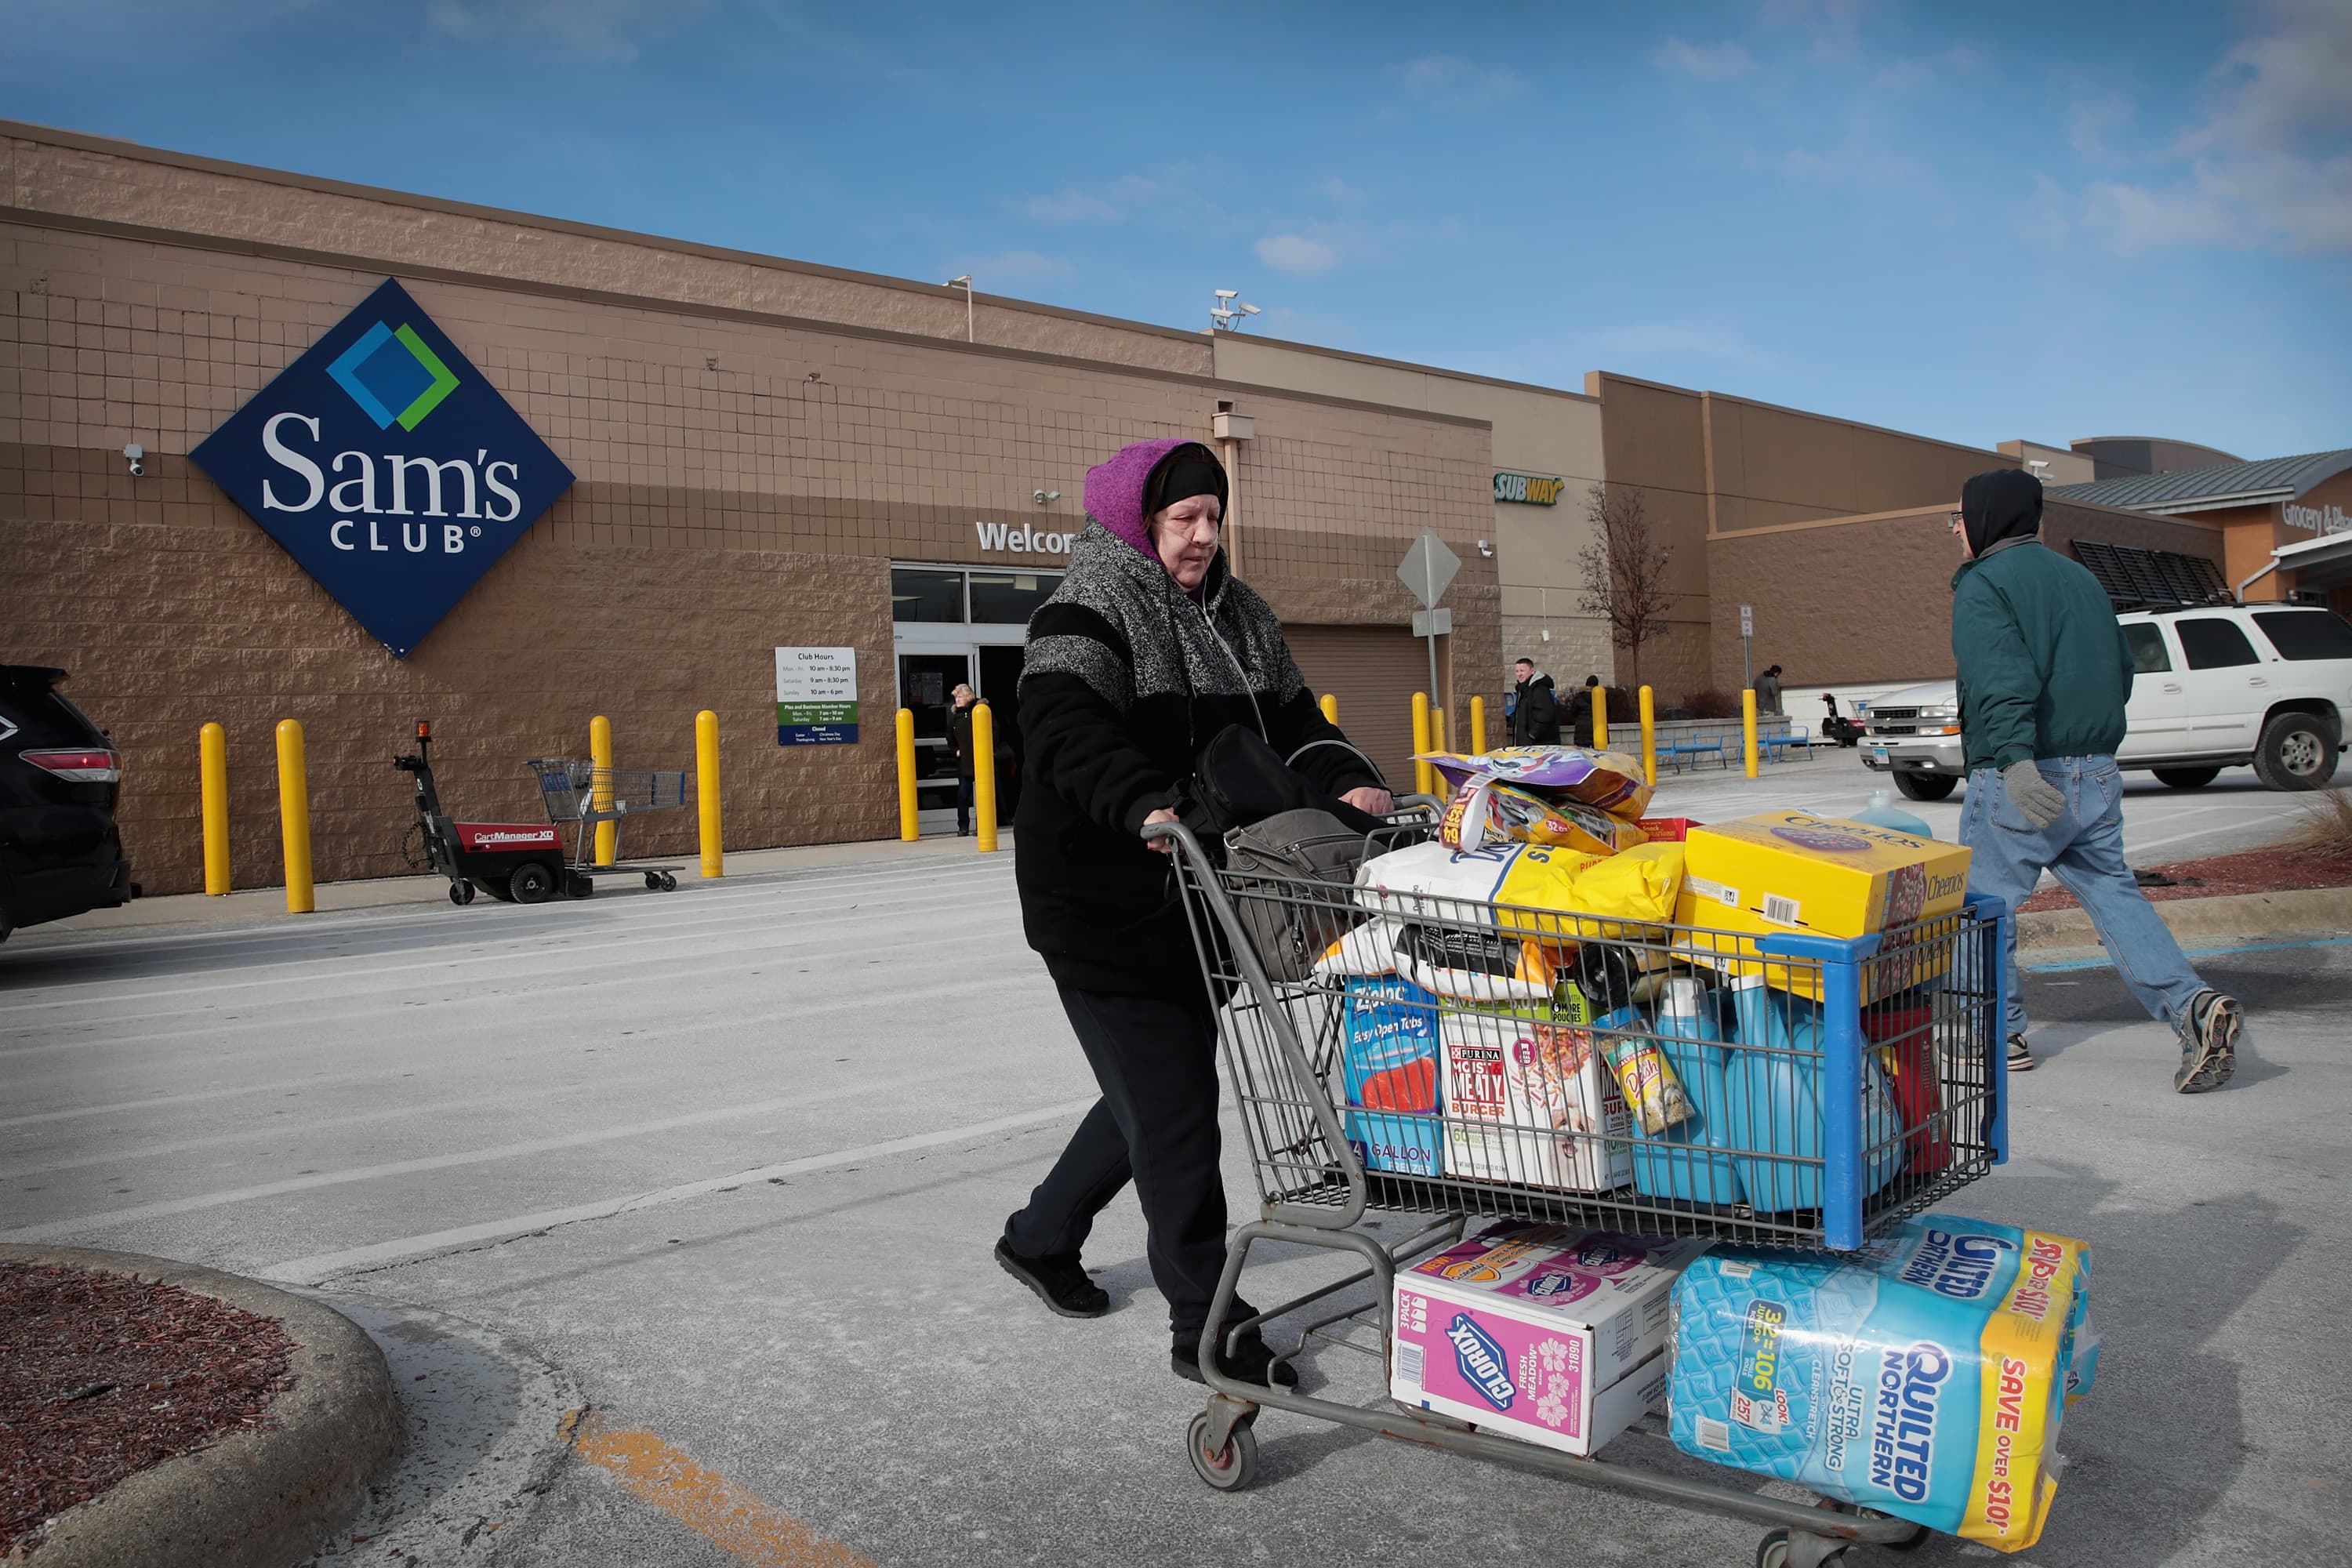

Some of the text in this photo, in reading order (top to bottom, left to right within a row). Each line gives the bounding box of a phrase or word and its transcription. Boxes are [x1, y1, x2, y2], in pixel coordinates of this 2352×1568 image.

[262, 412, 521, 522] Sam's
[1494, 474, 1563, 503] SUBWAY
[2282, 501, 2321, 538] Grocery
[976, 522, 1075, 554] Welco
[474, 832, 538, 841] CartManager
[1443, 827, 1459, 844] 64
[1547, 820, 1559, 832] 32
[1784, 816, 1926, 849] Cheerios
[1927, 872, 1965, 901] Cheerios
[1354, 1016, 1423, 1044] Easy Open Tabs
[1461, 1050, 1499, 1060] PURINA
[1453, 1073, 1502, 1102] MEATY
[1452, 1103, 1505, 1116] BURGER
[1371, 1144, 1431, 1162] GALLON
[1419, 1255, 1454, 1272] NEW!
[1902, 1229, 1951, 1287] ORTHERN
[1447, 1323, 1515, 1400] CLOROX
[1519, 1355, 1527, 1388] FRESH
[1568, 1339, 1580, 1373] 31890
[1753, 1349, 1776, 1392] 106
[1737, 1396, 1751, 1423] 257
[1776, 1389, 1788, 1424] LOOK!
[1806, 1359, 1822, 1439] CLEANSTRETCH
[1828, 1344, 1853, 1468] SOFT & STRONG
[1996, 1357, 2025, 1432] SAVE
[1845, 1387, 1862, 1438] ULTRA
[1871, 1351, 1904, 1487] NORTHERN
[1893, 1344, 1948, 1501] QUILTED
[1994, 1435, 2011, 1477] OVER
